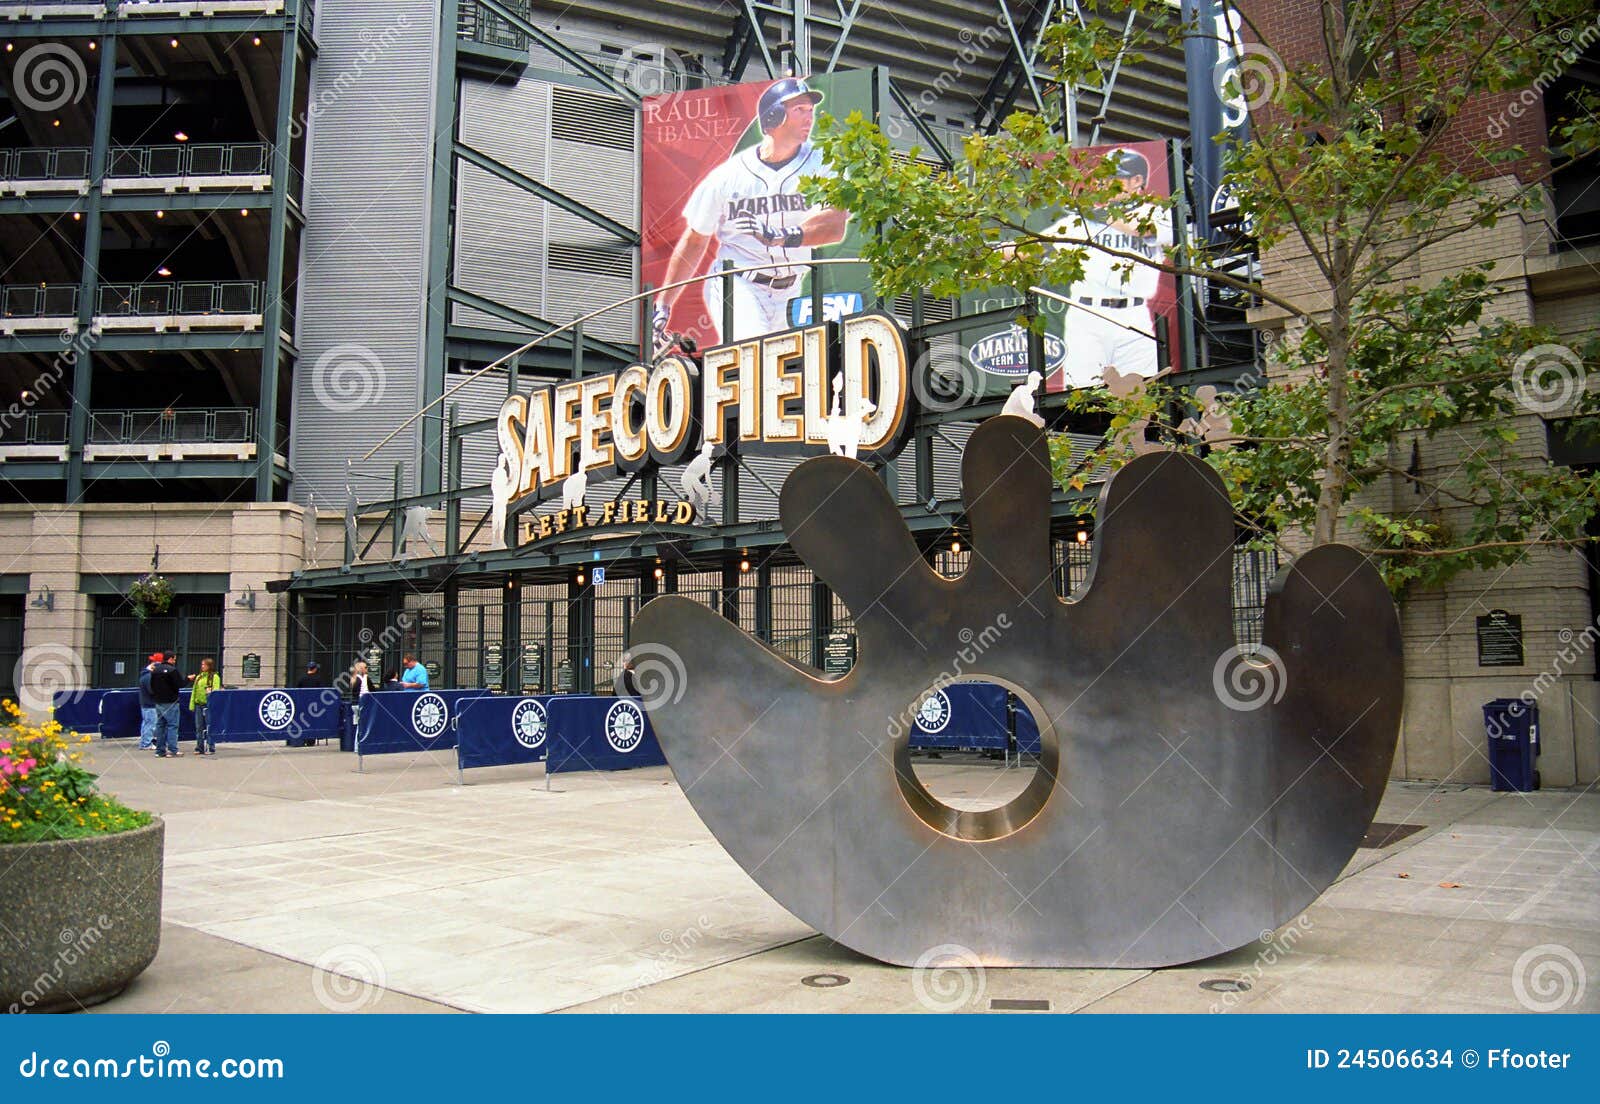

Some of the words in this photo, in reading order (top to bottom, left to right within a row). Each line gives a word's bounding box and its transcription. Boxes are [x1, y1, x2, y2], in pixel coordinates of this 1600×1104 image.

[647, 97, 719, 124] RAUL
[973, 296, 1066, 316] ICHIO
[978, 336, 1061, 361] MARINRS
[991, 354, 1014, 366] TEAM
[497, 357, 691, 504] SAFECO
[704, 315, 907, 450] FIELD
[524, 506, 586, 542] LEFT
[603, 500, 692, 524] FIELD
